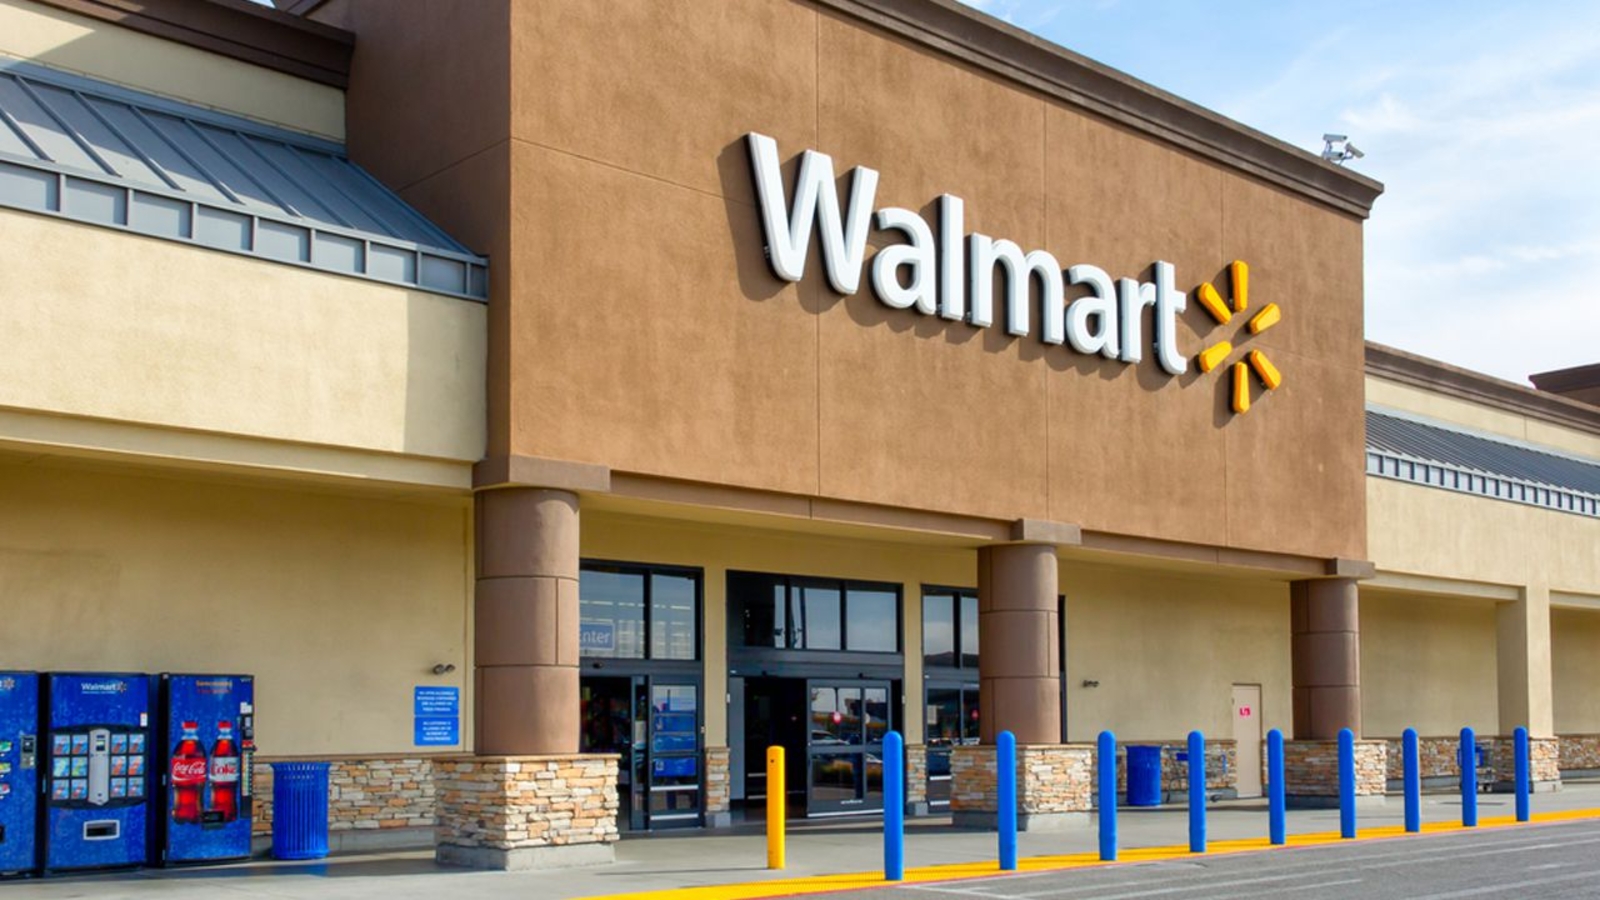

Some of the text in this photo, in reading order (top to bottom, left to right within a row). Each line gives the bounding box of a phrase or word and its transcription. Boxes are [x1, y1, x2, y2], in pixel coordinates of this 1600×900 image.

[747, 131, 1187, 375] Walmart
[579, 630, 610, 643] nter
[81, 682, 116, 690] Walmart
[211, 763, 236, 775] Coke
